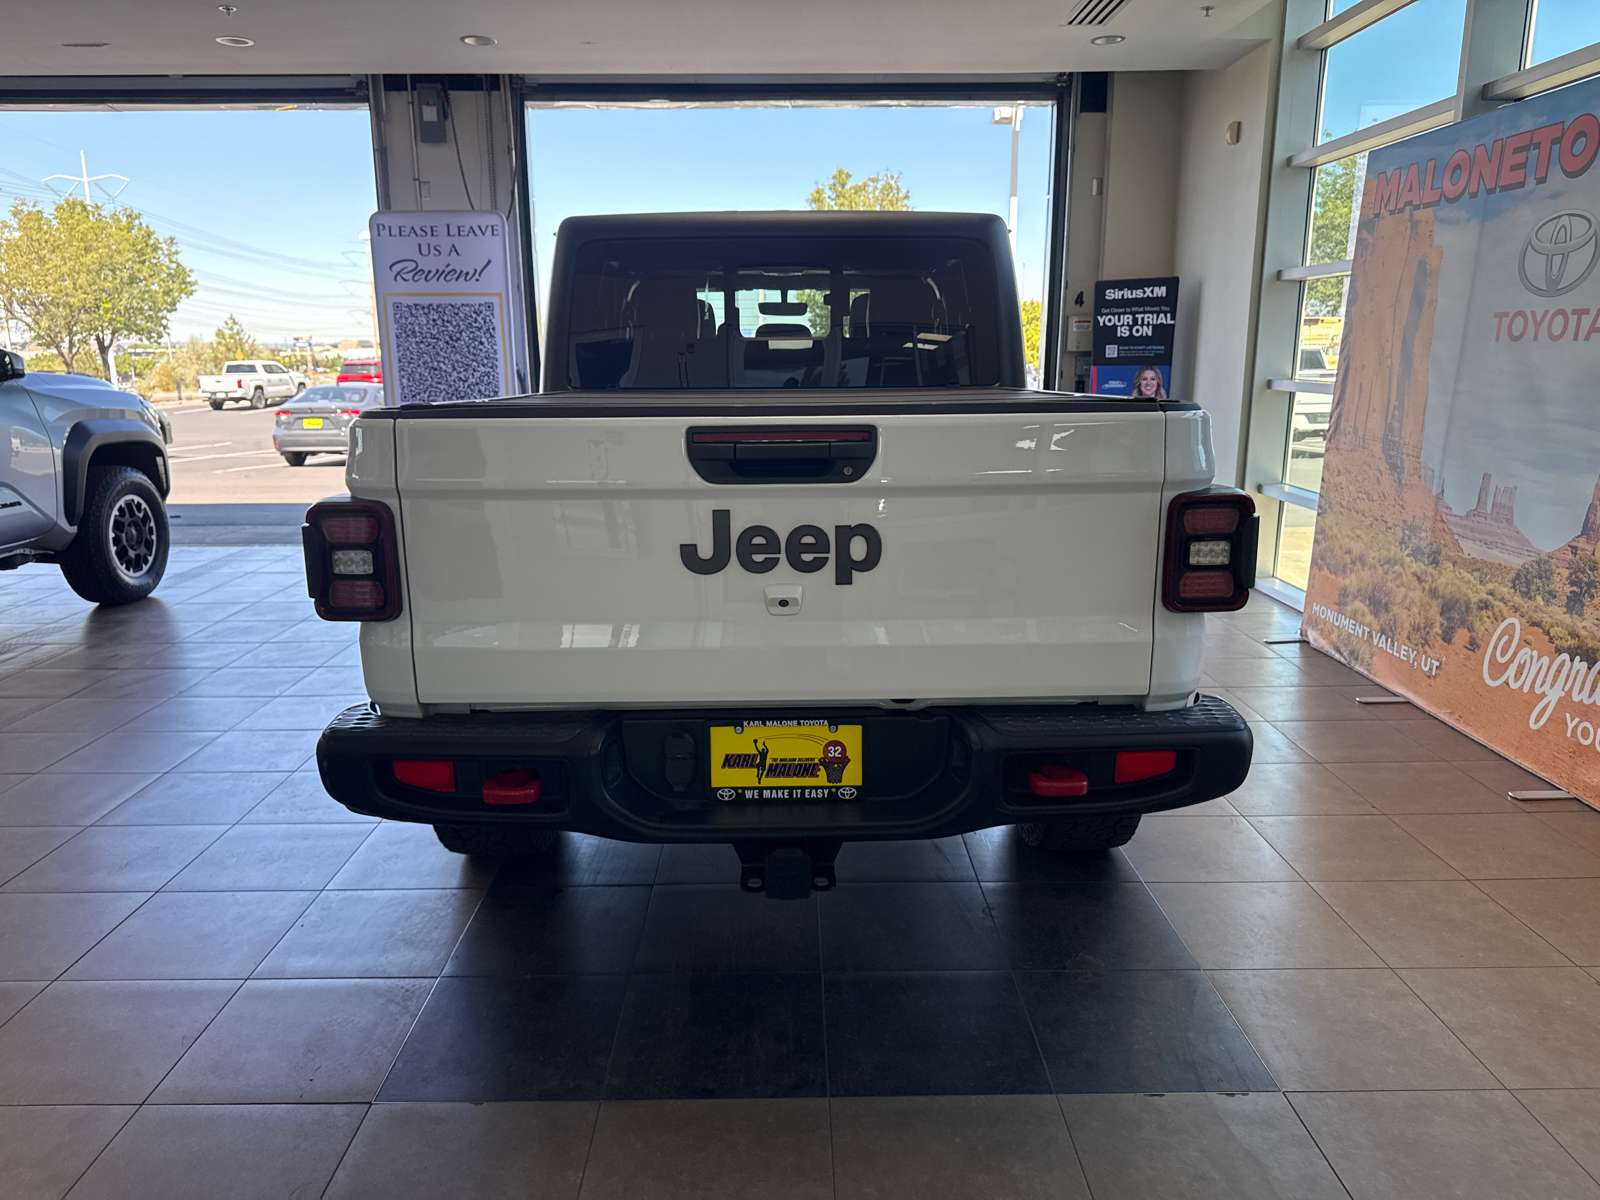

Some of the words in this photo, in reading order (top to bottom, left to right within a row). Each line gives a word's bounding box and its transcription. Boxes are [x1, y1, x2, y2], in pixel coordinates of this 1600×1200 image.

[376, 223, 438, 238] PLEASE
[446, 223, 500, 237] LEAVE
[447, 243, 461, 257] A
[389, 258, 492, 283] Review!
[1074, 291, 1085, 308] 4
[1105, 286, 1167, 300] SiriusXM
[1097, 314, 1133, 326] YOUR
[1135, 313, 1175, 325] TRIAL
[1117, 326, 1130, 337] IS
[1132, 325, 1152, 337] ON
[679, 509, 882, 585] Jeep
[1312, 602, 1371, 641] MONUMENT
[1372, 630, 1419, 670] VALLEY,
[1421, 655, 1440, 676] UT
[827, 746, 842, 758] 32
[721, 753, 759, 769] KARL
[765, 762, 821, 779] MALONE
[745, 789, 759, 799] WE
[763, 789, 789, 799] MAKE
[793, 788, 802, 799] IT
[805, 788, 829, 798] EASY
